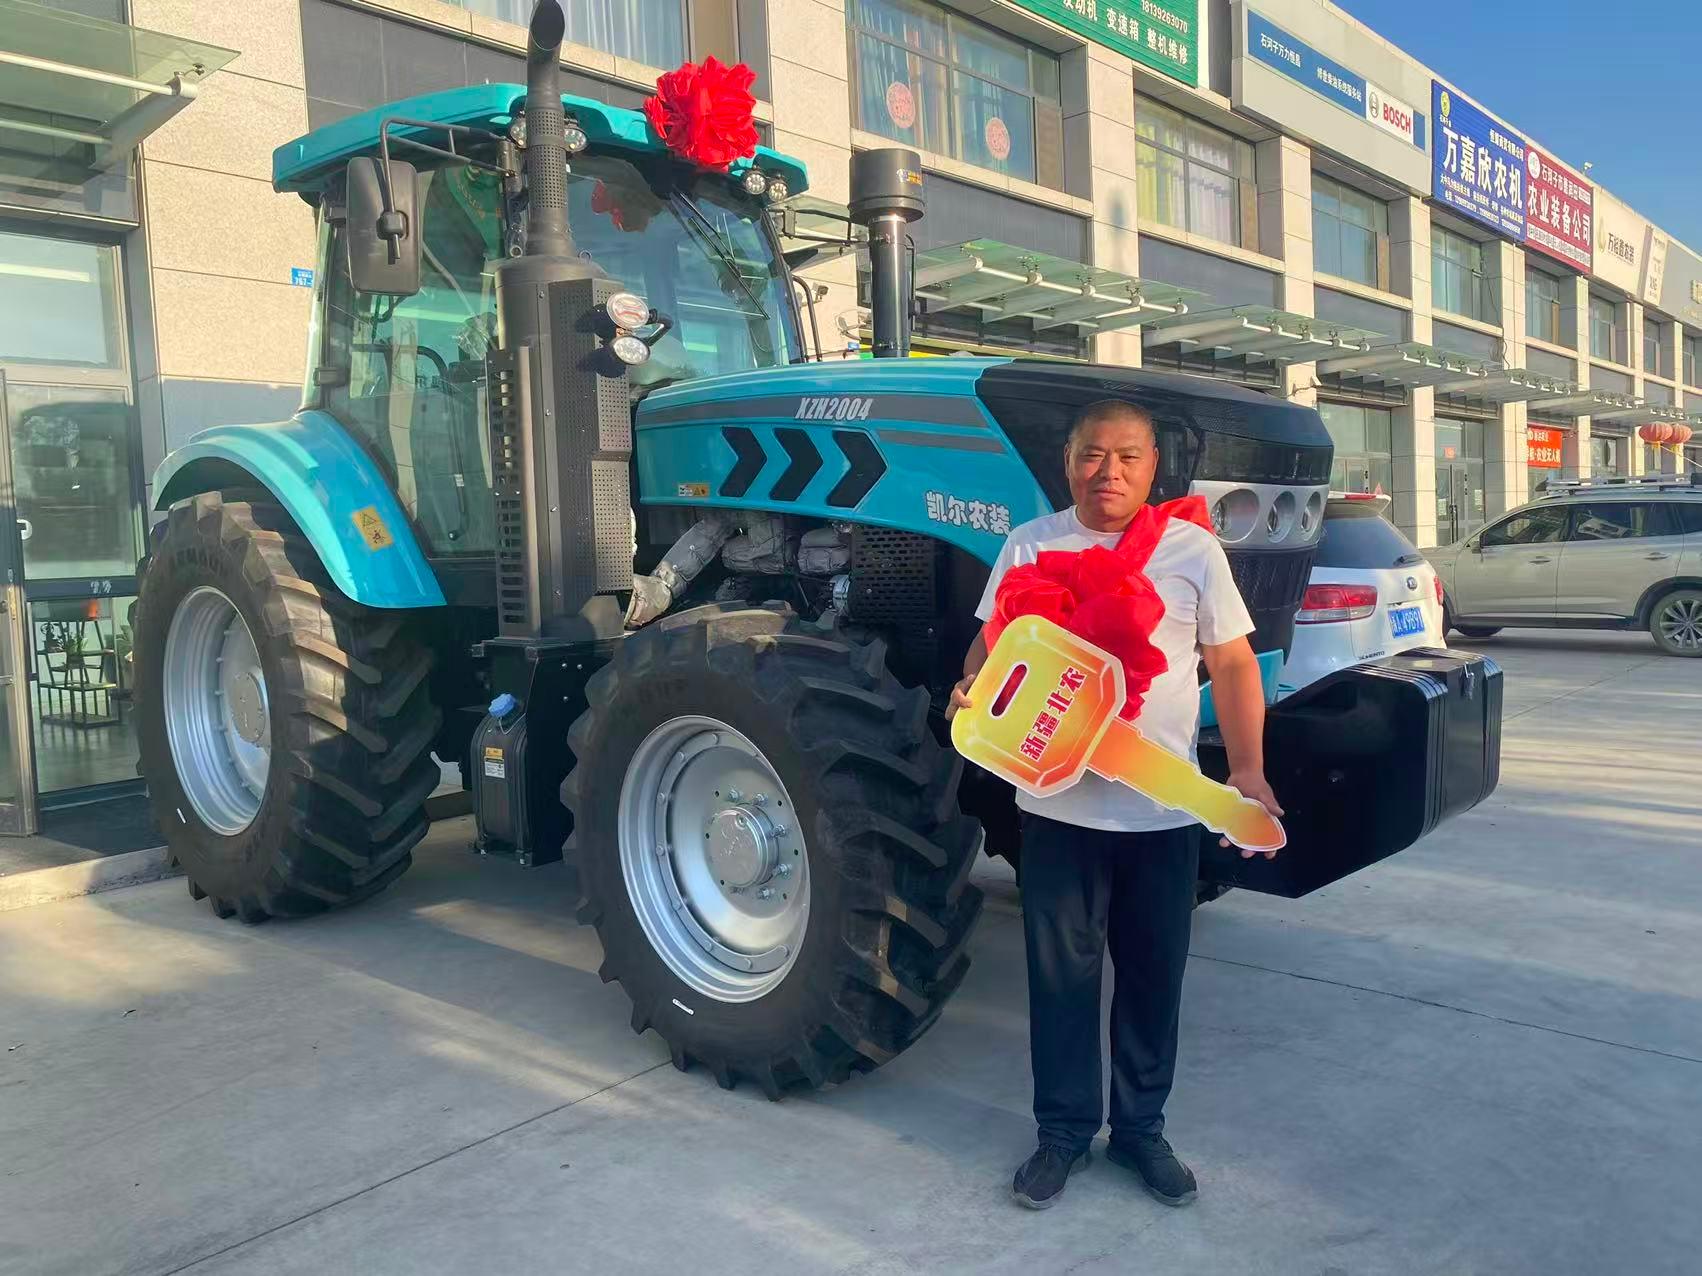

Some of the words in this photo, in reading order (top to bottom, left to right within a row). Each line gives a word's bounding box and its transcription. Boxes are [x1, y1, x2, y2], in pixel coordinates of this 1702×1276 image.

[1106, 8, 1139, 41] 变速箱
[1147, 28, 1187, 64] 整机维修
[1383, 103, 1411, 134] BOSCH
[1442, 126, 1523, 209] 万嘉欣农机
[1528, 182, 1590, 247] 农业装备公司
[926, 490, 1010, 537] 凯尔农装
[1019, 666, 1087, 762] 新疆北农
